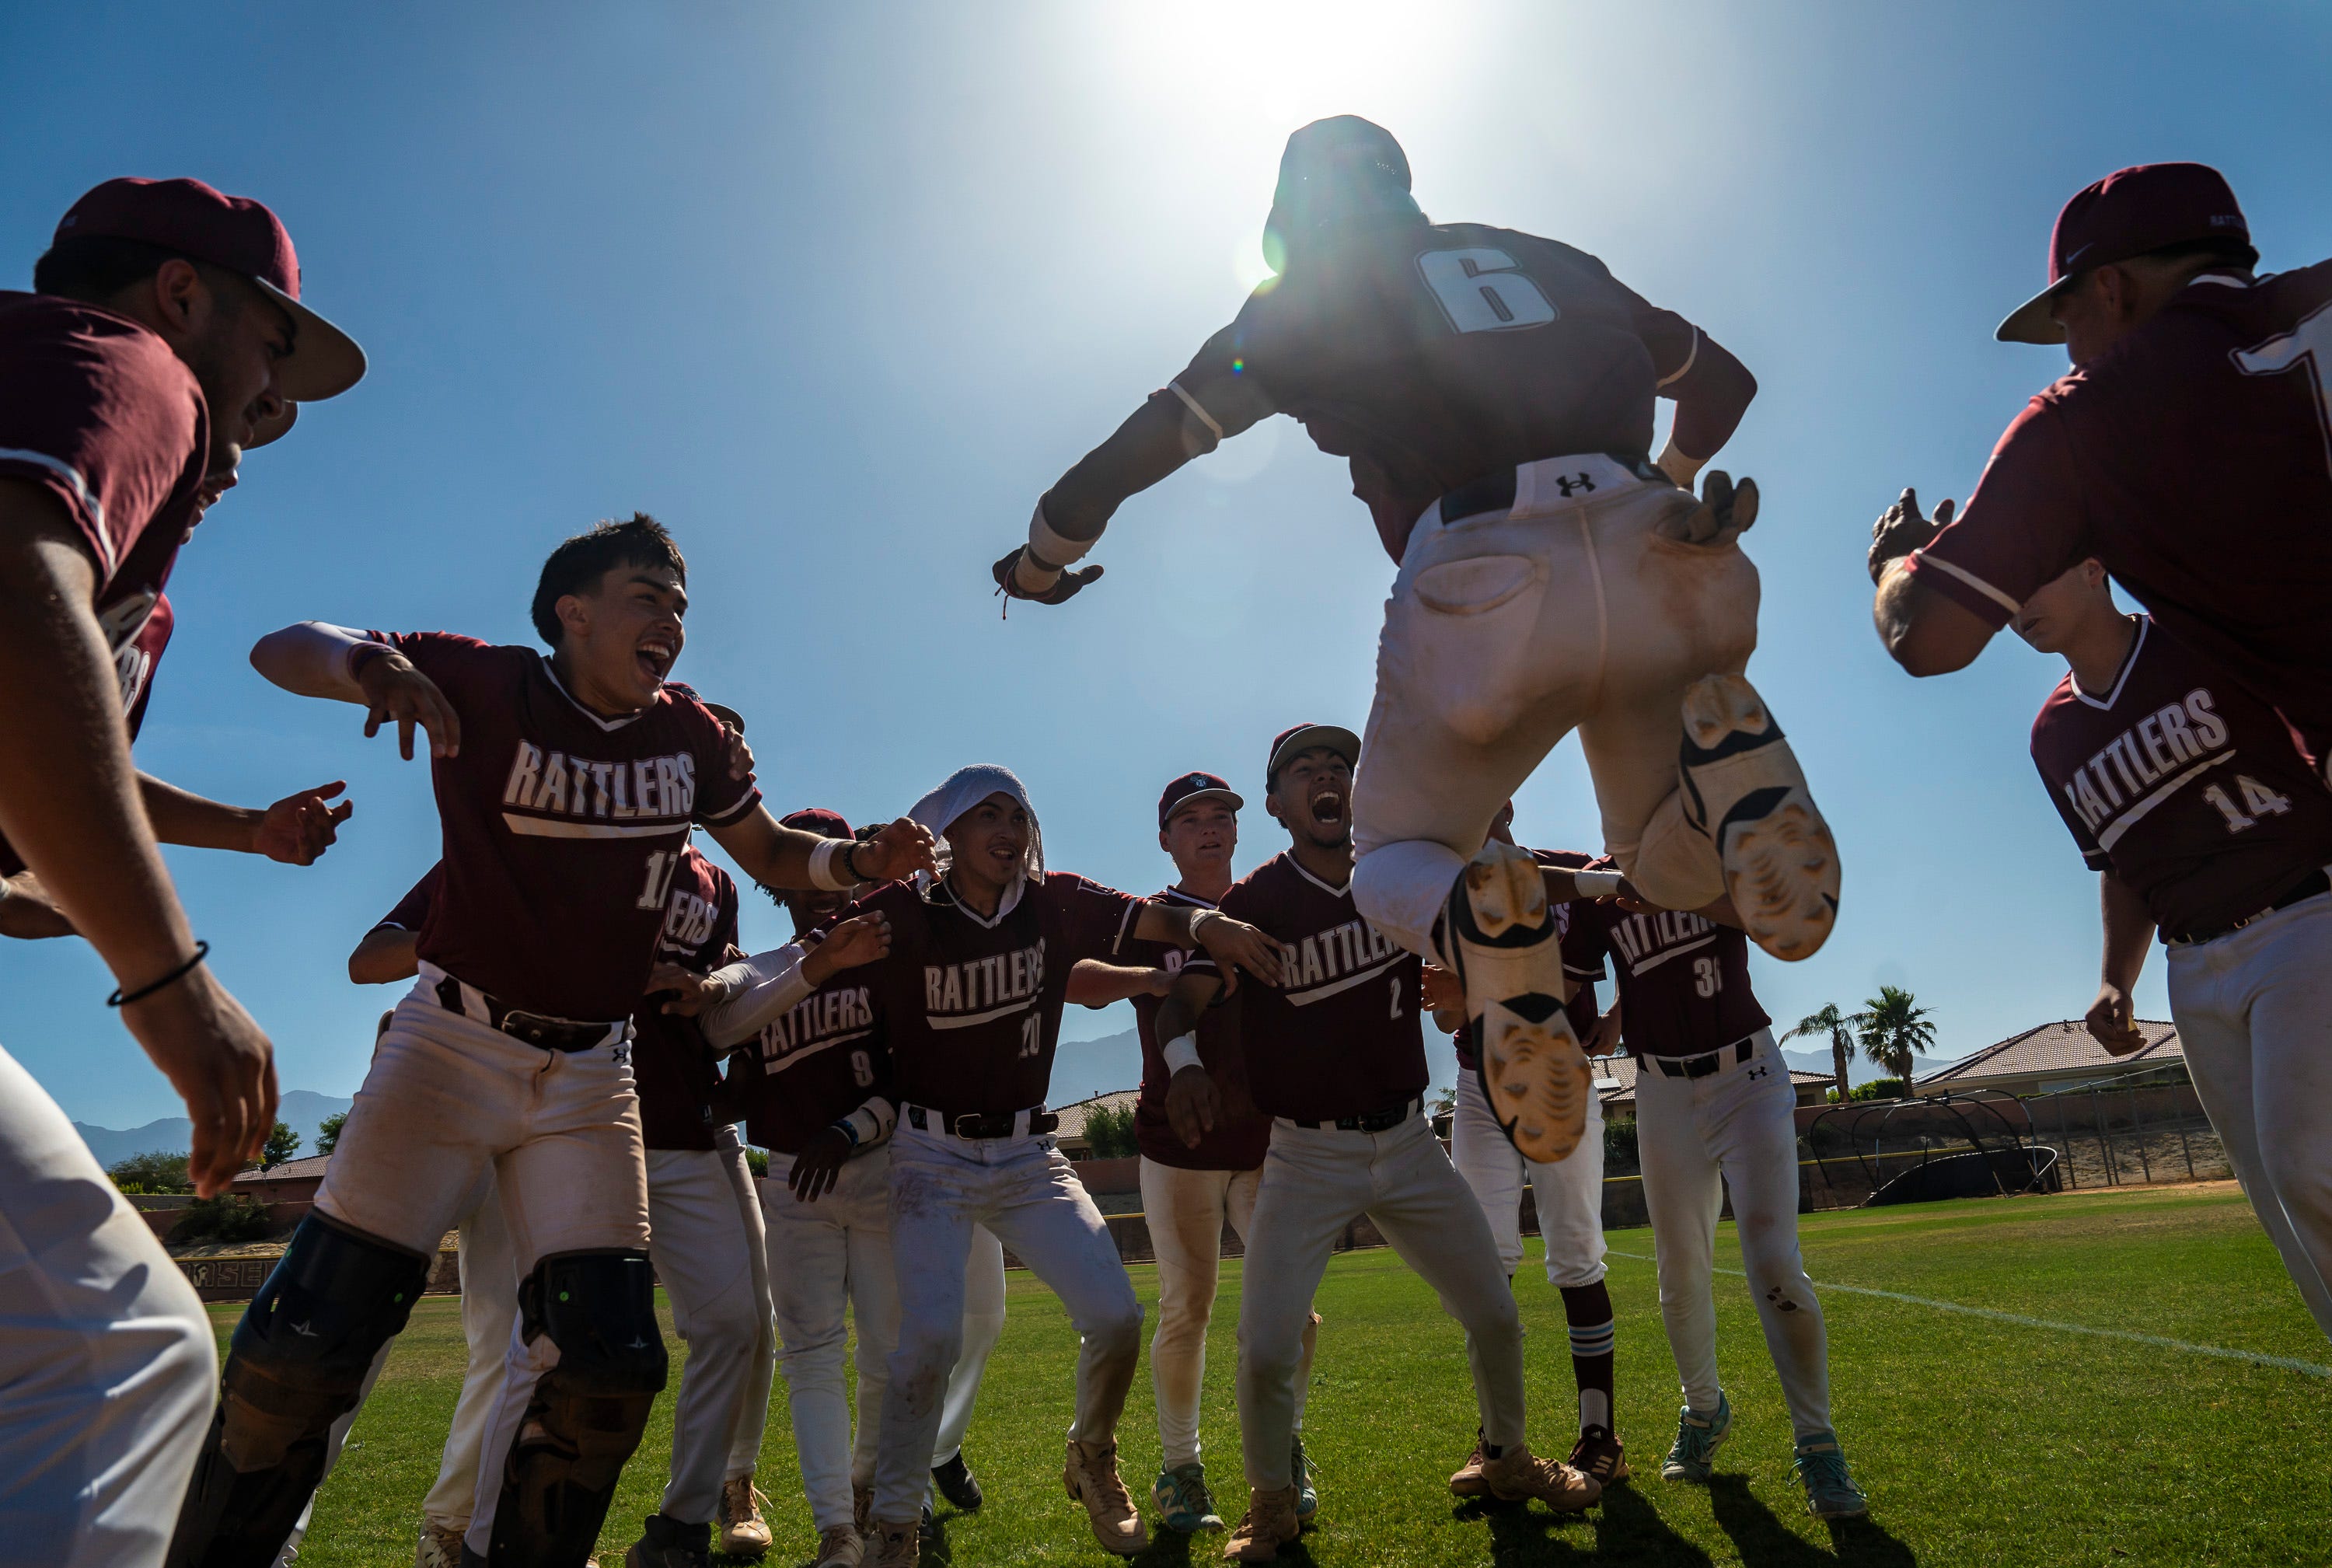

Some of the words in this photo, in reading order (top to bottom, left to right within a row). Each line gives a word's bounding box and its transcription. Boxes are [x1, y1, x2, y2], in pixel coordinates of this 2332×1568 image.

[1415, 247, 1560, 334] 6
[503, 739, 696, 819] RATTLERS
[2201, 774, 2292, 834] 14
[665, 889, 720, 946] ERS
[1389, 976, 1403, 1020] 2
[850, 1051, 874, 1088] 9
[178, 1260, 278, 1287] ASE
